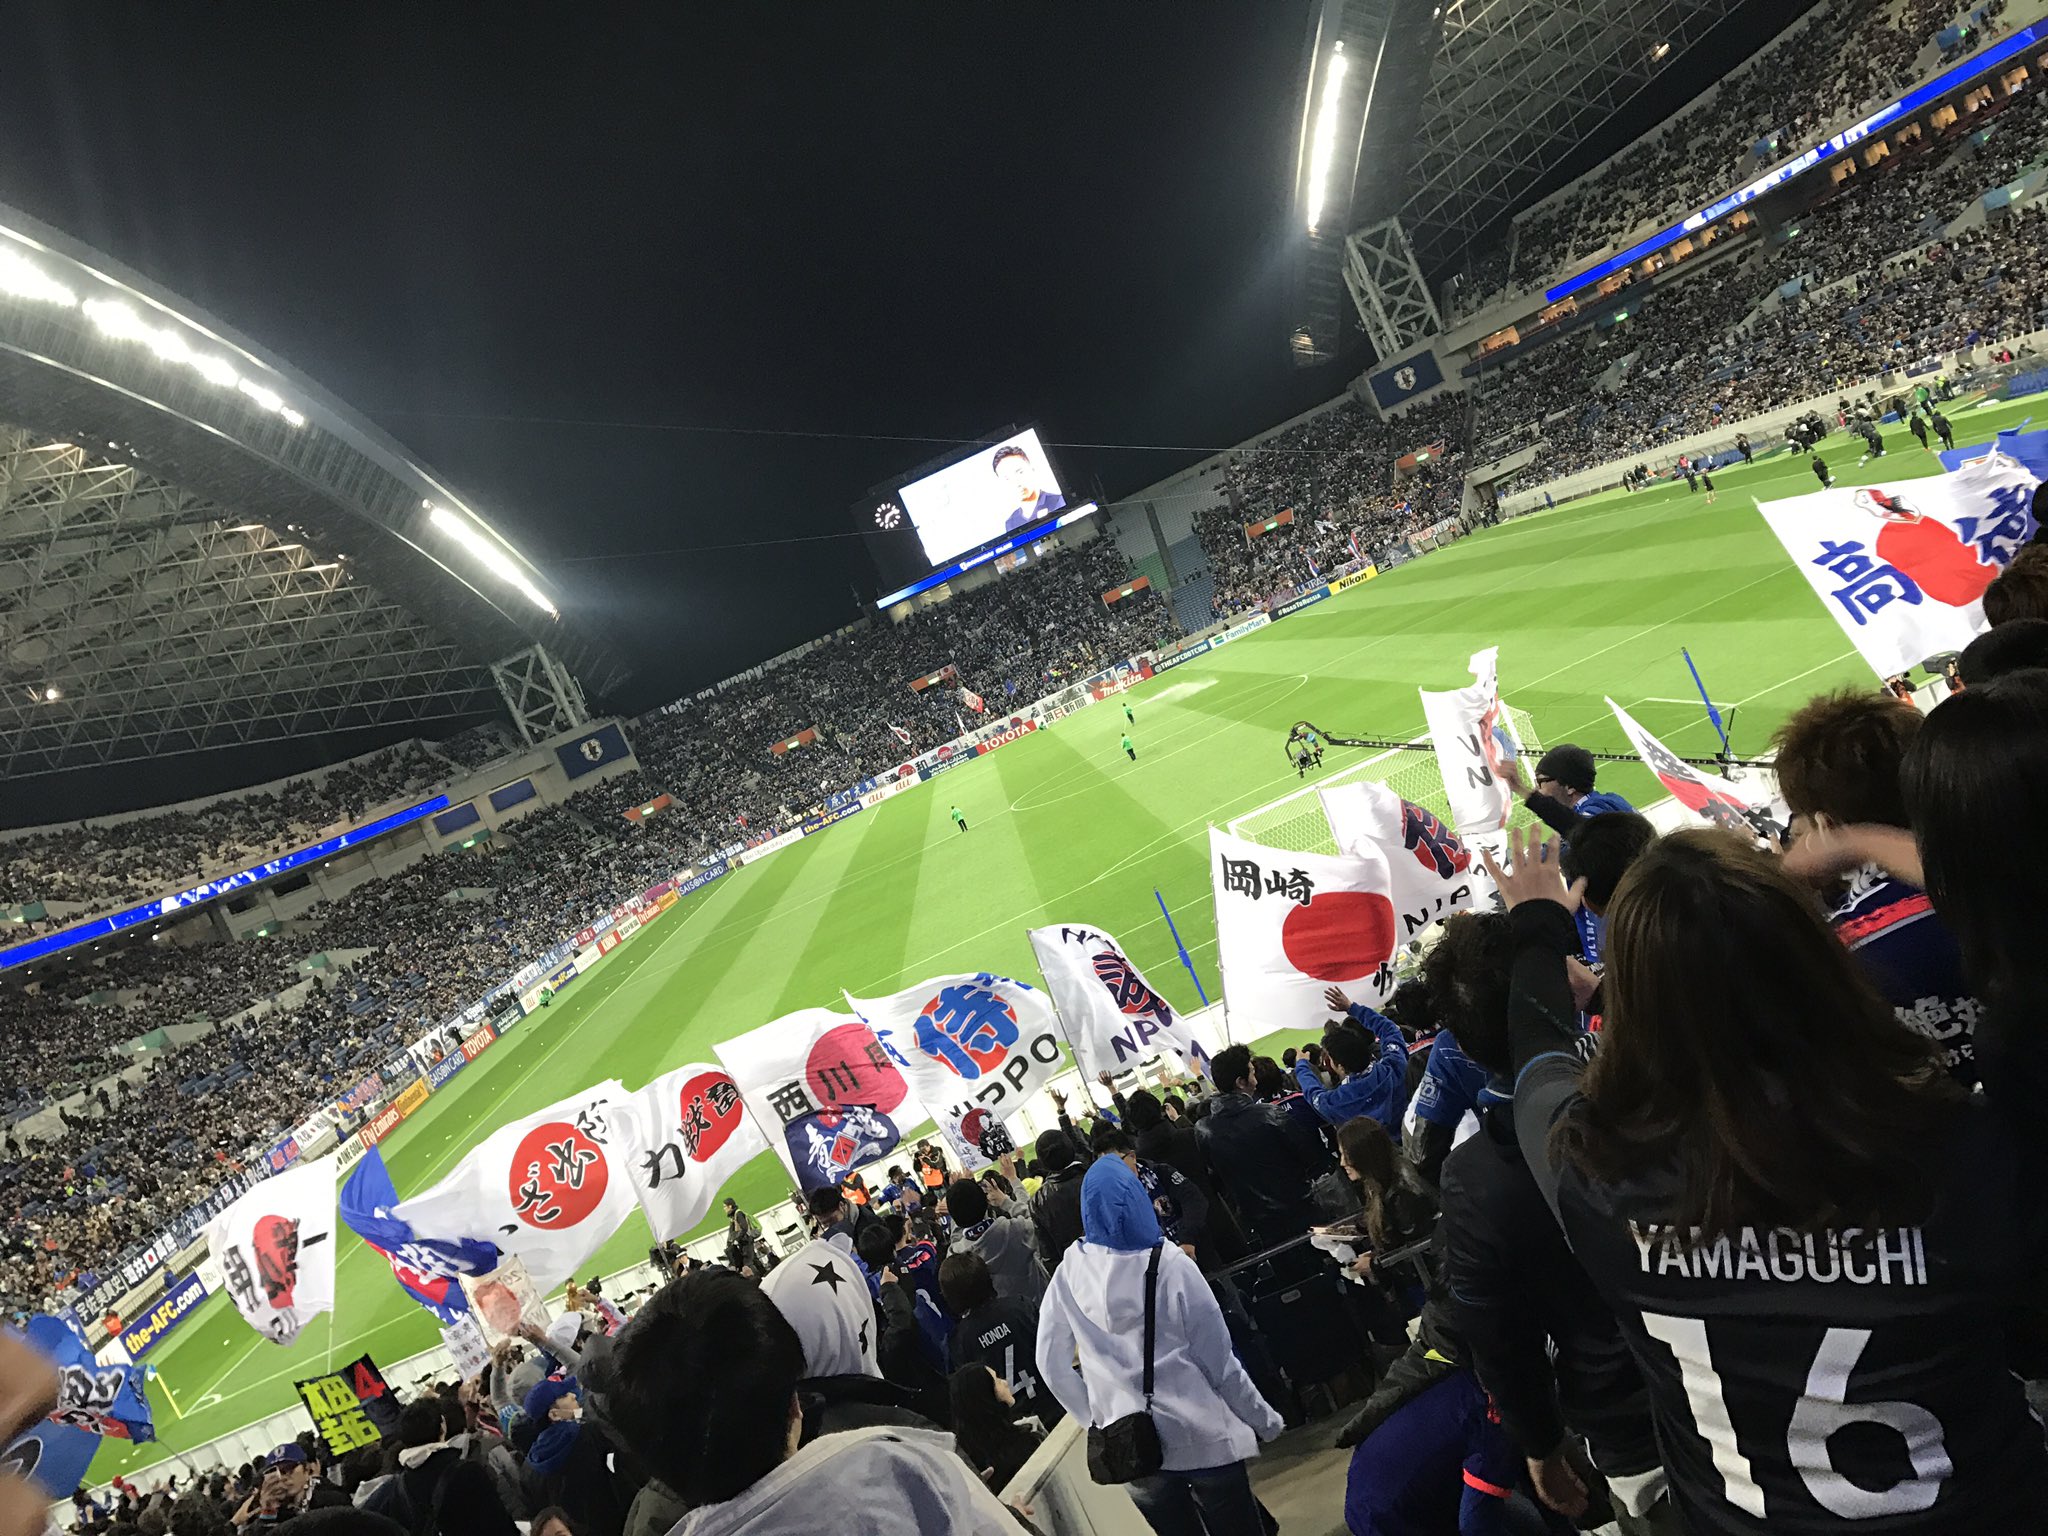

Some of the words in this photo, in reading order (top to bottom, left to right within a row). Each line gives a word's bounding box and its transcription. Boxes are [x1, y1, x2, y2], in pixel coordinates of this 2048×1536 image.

[1339, 572, 1367, 590] Nikon
[1225, 617, 1266, 640] FamilyMart
[982, 723, 1031, 752] TOYOTA
[804, 804, 860, 833] the-AFC.com
[704, 865, 724, 881] CARD
[1221, 852, 1315, 906] 岡崎
[463, 1028, 493, 1057] TOYOTA
[449, 1051, 465, 1072] CARD
[361, 1127, 378, 1146] Fly
[372, 1108, 399, 1137] Emirates
[1627, 1218, 1929, 1286] YAMAGUCHI
[125, 1282, 204, 1355] the-AFC.com
[978, 1322, 1012, 1349] HONDA
[353, 1362, 386, 1399] 4
[1005, 1343, 1037, 1400] 4
[1640, 1310, 1954, 1520] 16
